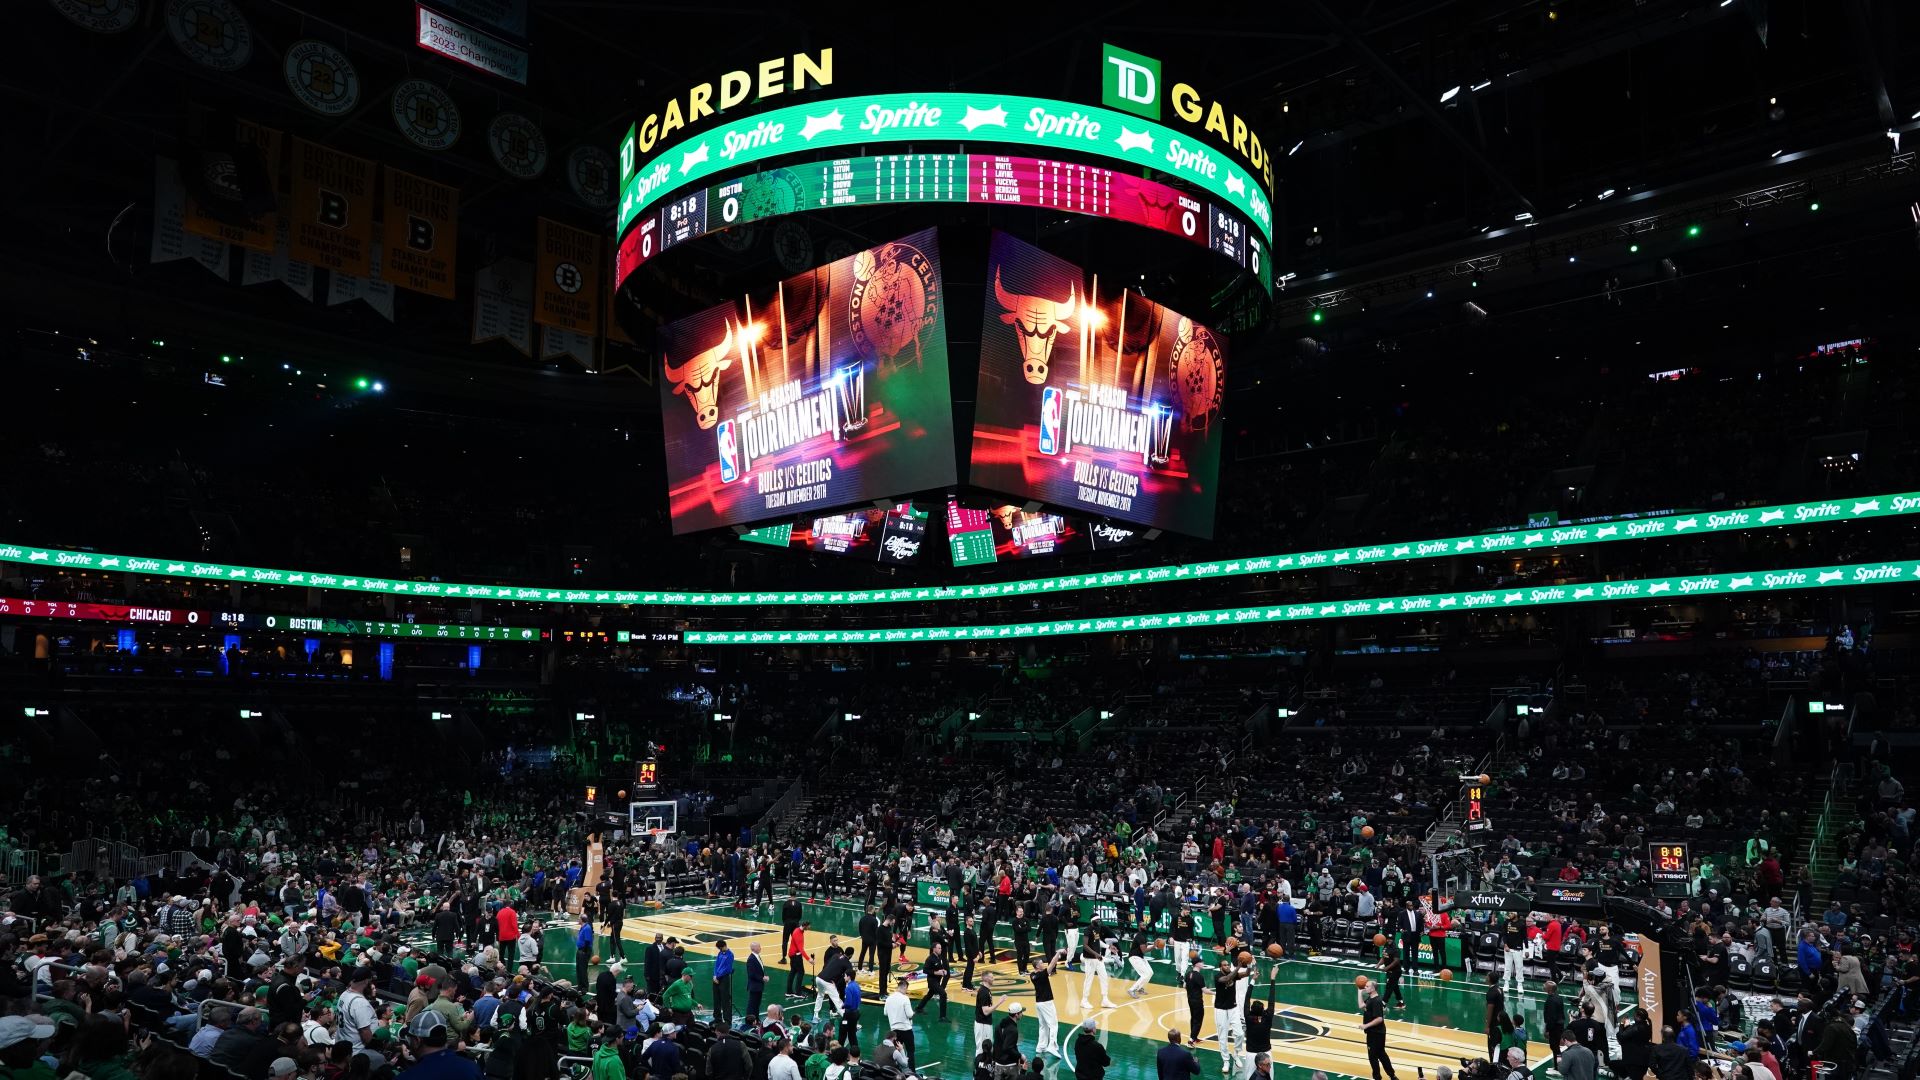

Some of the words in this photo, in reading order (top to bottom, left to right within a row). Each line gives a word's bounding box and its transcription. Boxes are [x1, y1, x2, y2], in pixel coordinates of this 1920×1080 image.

[430, 17, 467, 40] Boston
[469, 34, 520, 63] University
[432, 33, 457, 53] 2023
[459, 43, 519, 77] Champions
[313, 69, 332, 82] 22
[1108, 56, 1156, 105] TD
[417, 102, 434, 122] 16
[638, 48, 833, 154] GARDEN
[1171, 82, 1275, 200] GARDE
[304, 145, 367, 179] BOSTON
[620, 137, 635, 182] TD
[635, 161, 671, 205] Sprite
[720, 121, 783, 160] Sprite
[860, 103, 943, 135] Sprite
[1024, 106, 1102, 141] Sprite
[1166, 139, 1217, 180] Sprite
[1250, 188, 1270, 228] Sprite
[833, 165, 850, 174] TATUM
[995, 163, 1012, 171] WHITE
[303, 162, 366, 197] BRUINS
[833, 180, 851, 189] BROWN
[995, 170, 1014, 178] LAVINE
[995, 178, 1018, 186] VUCEVIC
[394, 173, 449, 204] BOSTON
[718, 182, 743, 199] BOSTON
[833, 188, 849, 196] WHITE
[995, 186, 1019, 194] DEROZAN
[995, 193, 1021, 202] WILLIAMS
[394, 187, 449, 222] BRUINS
[670, 196, 697, 221] 8:18
[722, 197, 739, 223] 0
[1178, 195, 1201, 213] CHICAGO
[545, 222, 593, 250] BOSTON
[1181, 211, 1196, 236] 0
[1218, 212, 1239, 238] 8:18
[545, 238, 593, 266] BRUINS
[642, 233, 652, 258] 0
[391, 259, 447, 284] CHAMPIONS
[1251, 250, 1260, 275] 0
[910, 253, 937, 326] CELTICS
[759, 378, 802, 414] IN-SEASON
[1089, 383, 1128, 410] IN-SEASON
[737, 380, 845, 472] TOURNAMENT
[1065, 389, 1157, 465] TOURNAMENT
[758, 468, 783, 494] BULLS
[784, 466, 795, 488] VS
[796, 457, 832, 486] CELTICS
[1073, 460, 1099, 487] BULLS
[1099, 466, 1110, 489] VS
[1109, 470, 1139, 497] CELTICS
[765, 492, 787, 509] TUESDAY,
[786, 487, 812, 505] NOVEMBER
[813, 484, 827, 500] 28TH
[1097, 491, 1121, 510] NOVEMBER
[899, 521, 914, 531] 8:18
[56, 553, 92, 564] Sprite
[126, 559, 160, 570] Sprite
[192, 565, 222, 575] Sprite
[252, 570, 282, 580] Sprite
[308, 575, 336, 585] Sprite
[362, 580, 388, 589] Sprite
[412, 584, 440, 593] Sprite
[466, 587, 492, 596] Sprite
[516, 590, 542, 598] Sprite
[566, 592, 590, 600] Sprite
[614, 593, 638, 602] Sprite
[662, 594, 686, 603] Sprite
[710, 595, 732, 603] Sprite
[756, 594, 778, 603] Sprite
[800, 594, 824, 602] Sprite
[848, 592, 868, 602] Sprite
[890, 591, 912, 600] Sprite
[934, 588, 956, 598] Sprite
[978, 586, 998, 596] Sprite
[1018, 582, 1038, 592] Sprite
[1058, 578, 1080, 588] Sprite
[1100, 574, 1124, 584] Sprite
[1146, 569, 1170, 580] Sprite
[1194, 564, 1220, 576] Sprite
[1244, 559, 1272, 571] Sprite
[1298, 554, 1326, 566] Sprite
[1356, 548, 1386, 560] Sprite
[1416, 542, 1448, 555] Sprite
[1480, 534, 1518, 549] Sprite
[1550, 528, 1590, 543] Sprite
[1626, 520, 1664, 536] Sprite
[1706, 513, 1748, 528] Sprite
[1794, 504, 1840, 520] Sprite
[706, 634, 728, 642] Sprite
[750, 633, 774, 642] Sprite
[796, 633, 820, 641] Sprite
[842, 633, 864, 641] Sprite
[884, 631, 906, 640] Sprite
[928, 630, 950, 639] Sprite
[972, 628, 994, 638] Sprite
[1014, 626, 1034, 636] Sprite
[1054, 623, 1074, 633] Sprite
[1094, 620, 1118, 630] Sprite
[1138, 617, 1162, 628] Sprite
[1186, 613, 1210, 624] Sprite
[1234, 610, 1260, 621] Sprite
[1286, 606, 1314, 618] Sprite
[1342, 602, 1370, 615] Sprite
[1400, 598, 1432, 611] Sprite
[1462, 594, 1496, 607] Sprite
[1530, 588, 1564, 602] Sprite
[1602, 583, 1640, 598] Sprite
[1678, 578, 1720, 593] Sprite
[1762, 572, 1806, 588] Sprite
[1854, 566, 1902, 582] Sprite
[129, 608, 171, 622] CHICAGO
[188, 611, 198, 624] 0
[221, 611, 244, 623] 8:18
[266, 616, 276, 628] 0
[290, 618, 323, 631] BOSTON
[652, 633, 667, 641] 7:24
[667, 633, 679, 641] PM
[640, 771, 654, 783] 24
[1469, 800, 1481, 821] 24
[1661, 846, 1682, 857] 8:18
[1661, 857, 1679, 870] 24
[1471, 893, 1506, 908] xfinity
[1561, 889, 1585, 898] Sports
[1738, 963, 1746, 971] G
[1761, 966, 1770, 974] G
[1641, 967, 1659, 1013] xfinity
